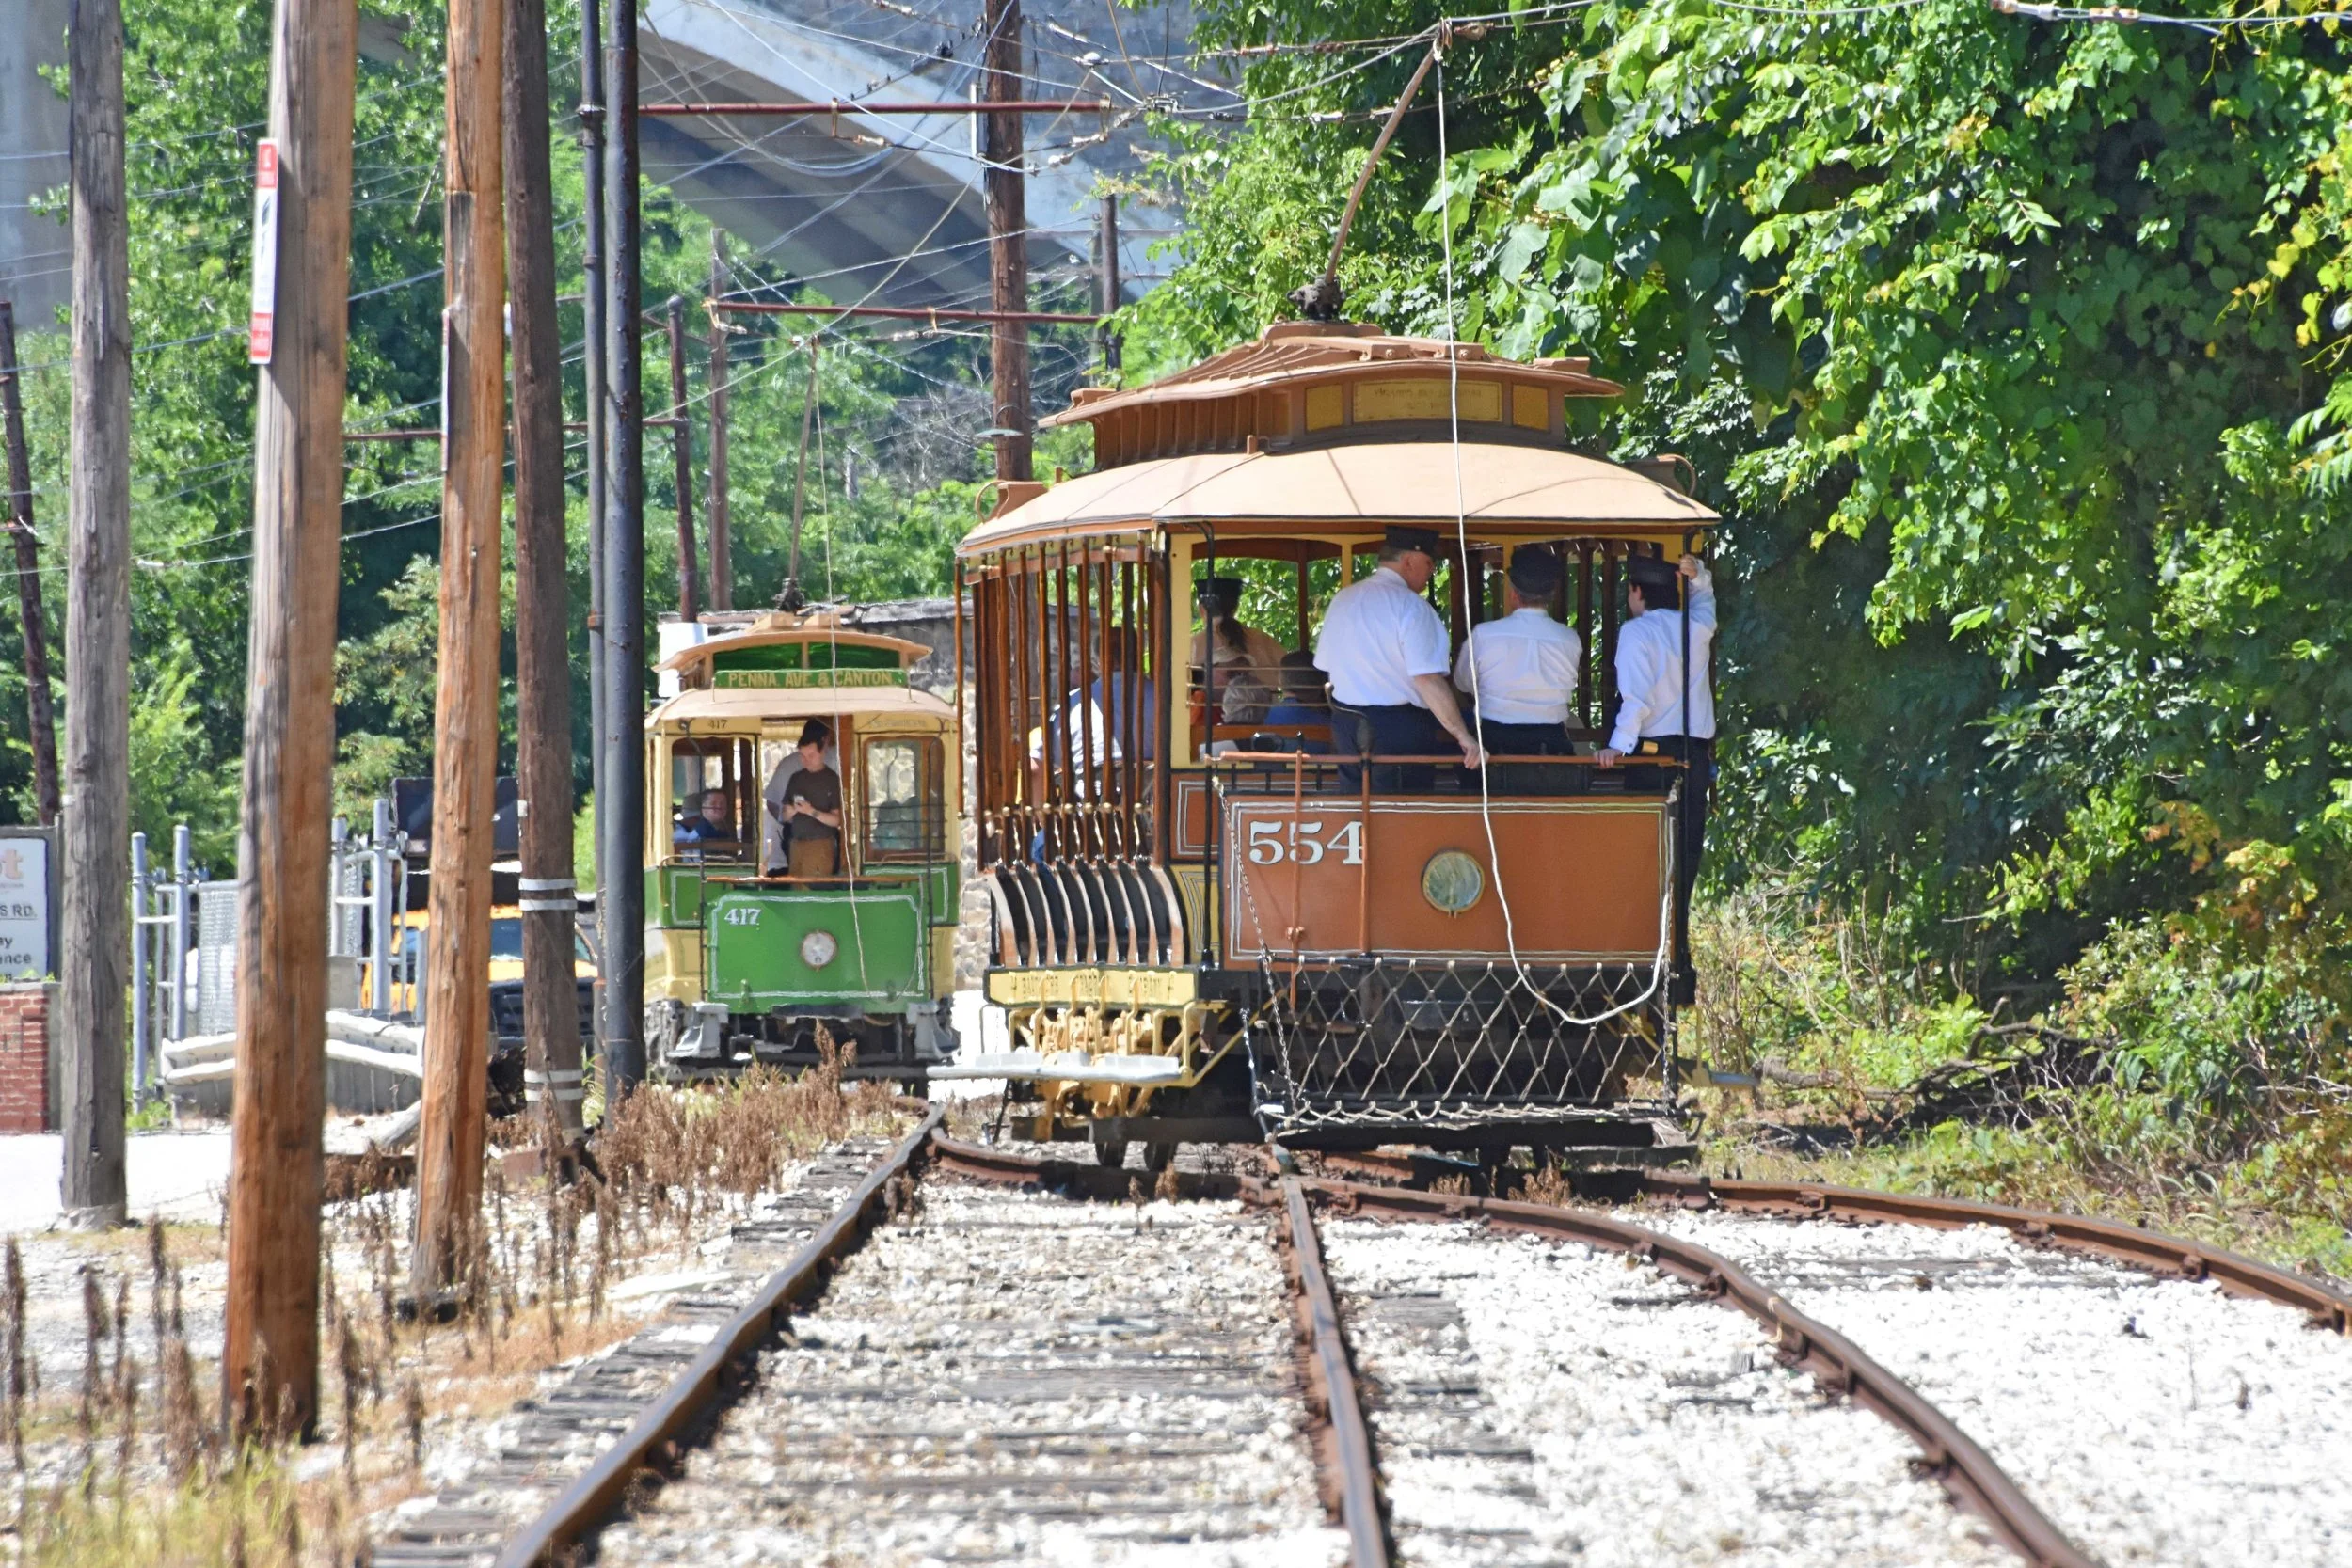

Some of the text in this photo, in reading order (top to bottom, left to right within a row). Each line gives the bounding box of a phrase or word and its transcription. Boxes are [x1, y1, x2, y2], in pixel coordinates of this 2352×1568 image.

[818, 671, 829, 687] &
[707, 718, 729, 730] 417
[1248, 820, 1364, 865] 554
[723, 908, 761, 926] 417
